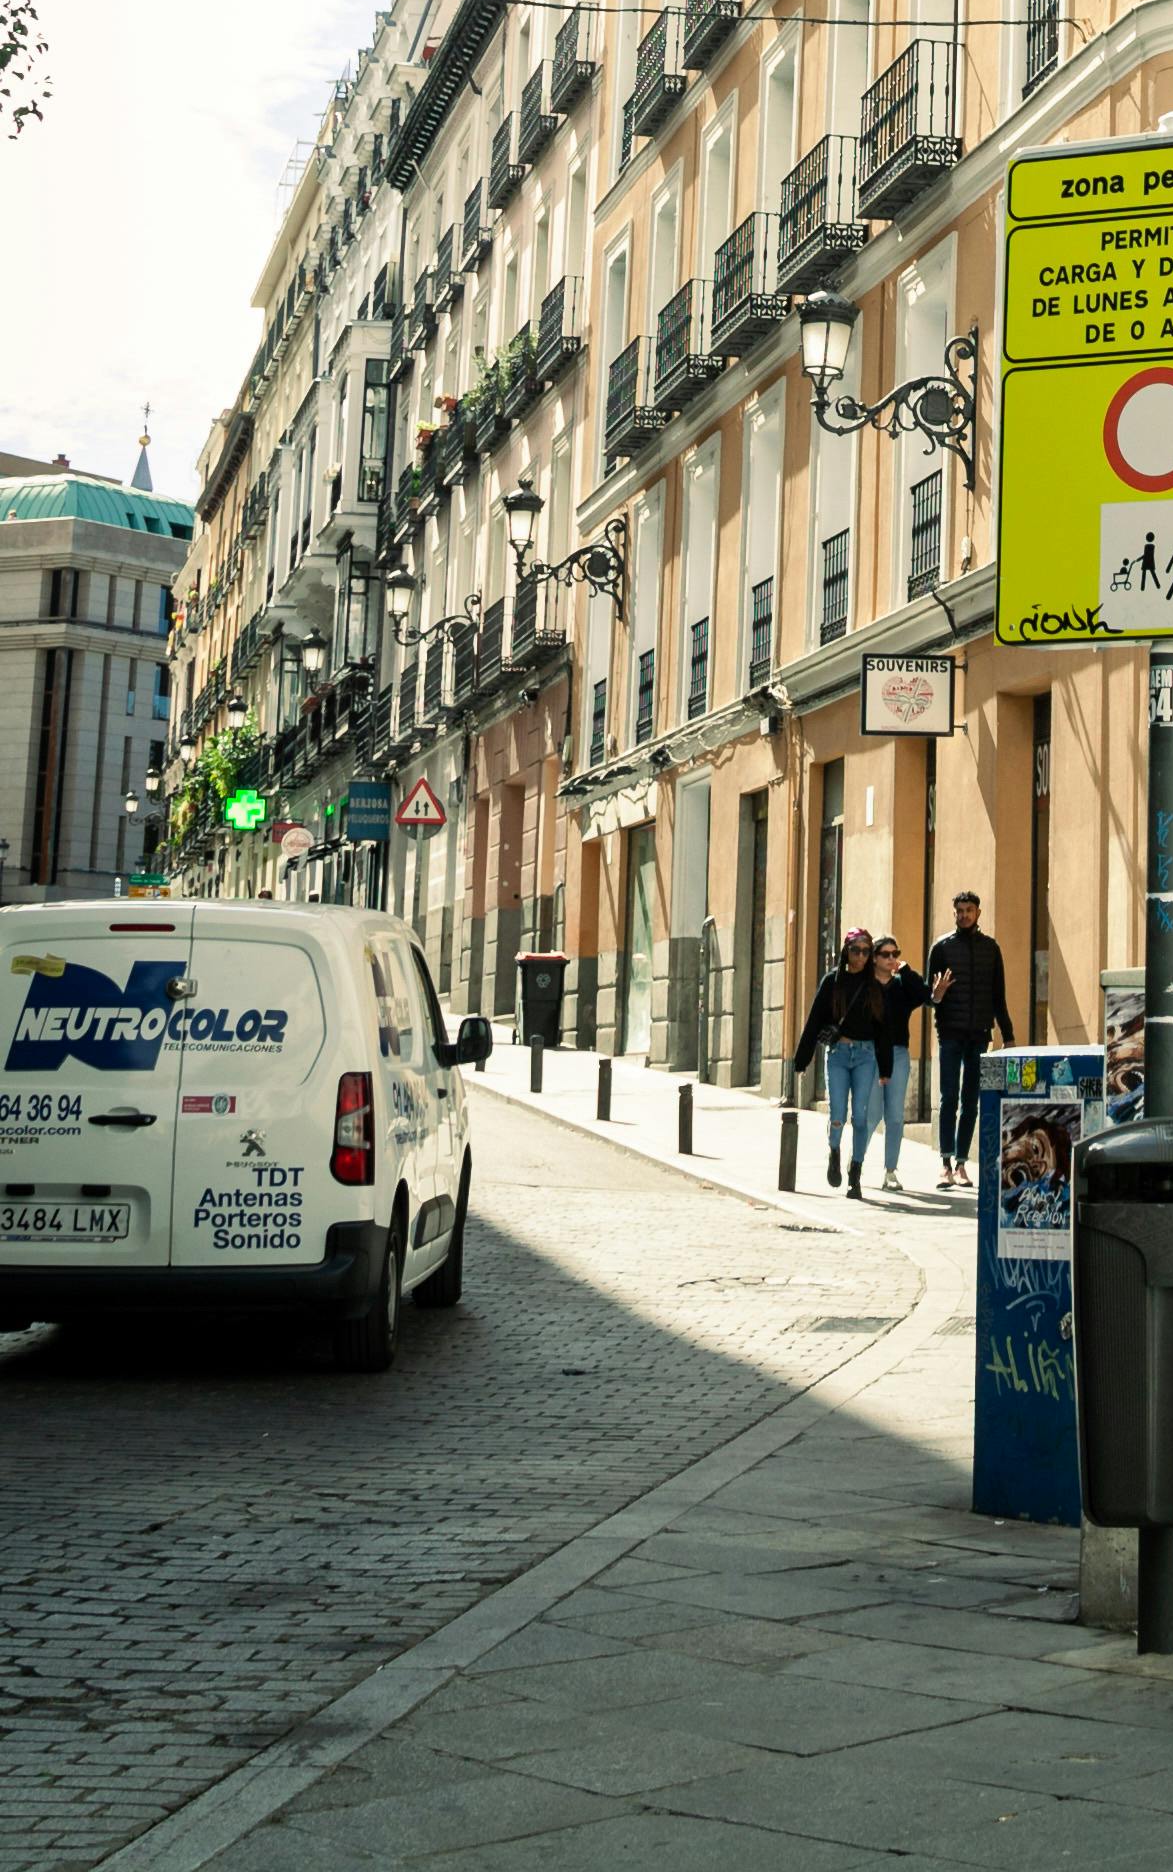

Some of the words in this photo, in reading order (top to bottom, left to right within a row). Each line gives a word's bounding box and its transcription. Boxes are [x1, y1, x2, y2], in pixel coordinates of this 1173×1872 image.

[1060, 173, 1125, 199] zona
[1039, 261, 1118, 287] CARGA
[1132, 259, 1146, 279] Y
[1032, 297, 1061, 318] DE
[1073, 289, 1149, 315] LUNES
[1085, 323, 1116, 344] DE
[866, 659, 949, 674] SOUVENIRS
[15, 1007, 289, 1043] NEUTROCOLOR
[27, 1094, 52, 1122] 36
[57, 1094, 82, 1122] 94
[252, 1167, 304, 1187] TDT
[199, 1188, 303, 1208] Antenas
[1, 1208, 63, 1231] 3484
[73, 1209, 122, 1233] LMX
[194, 1208, 302, 1228] Porteros
[213, 1229, 302, 1249] Sonido
